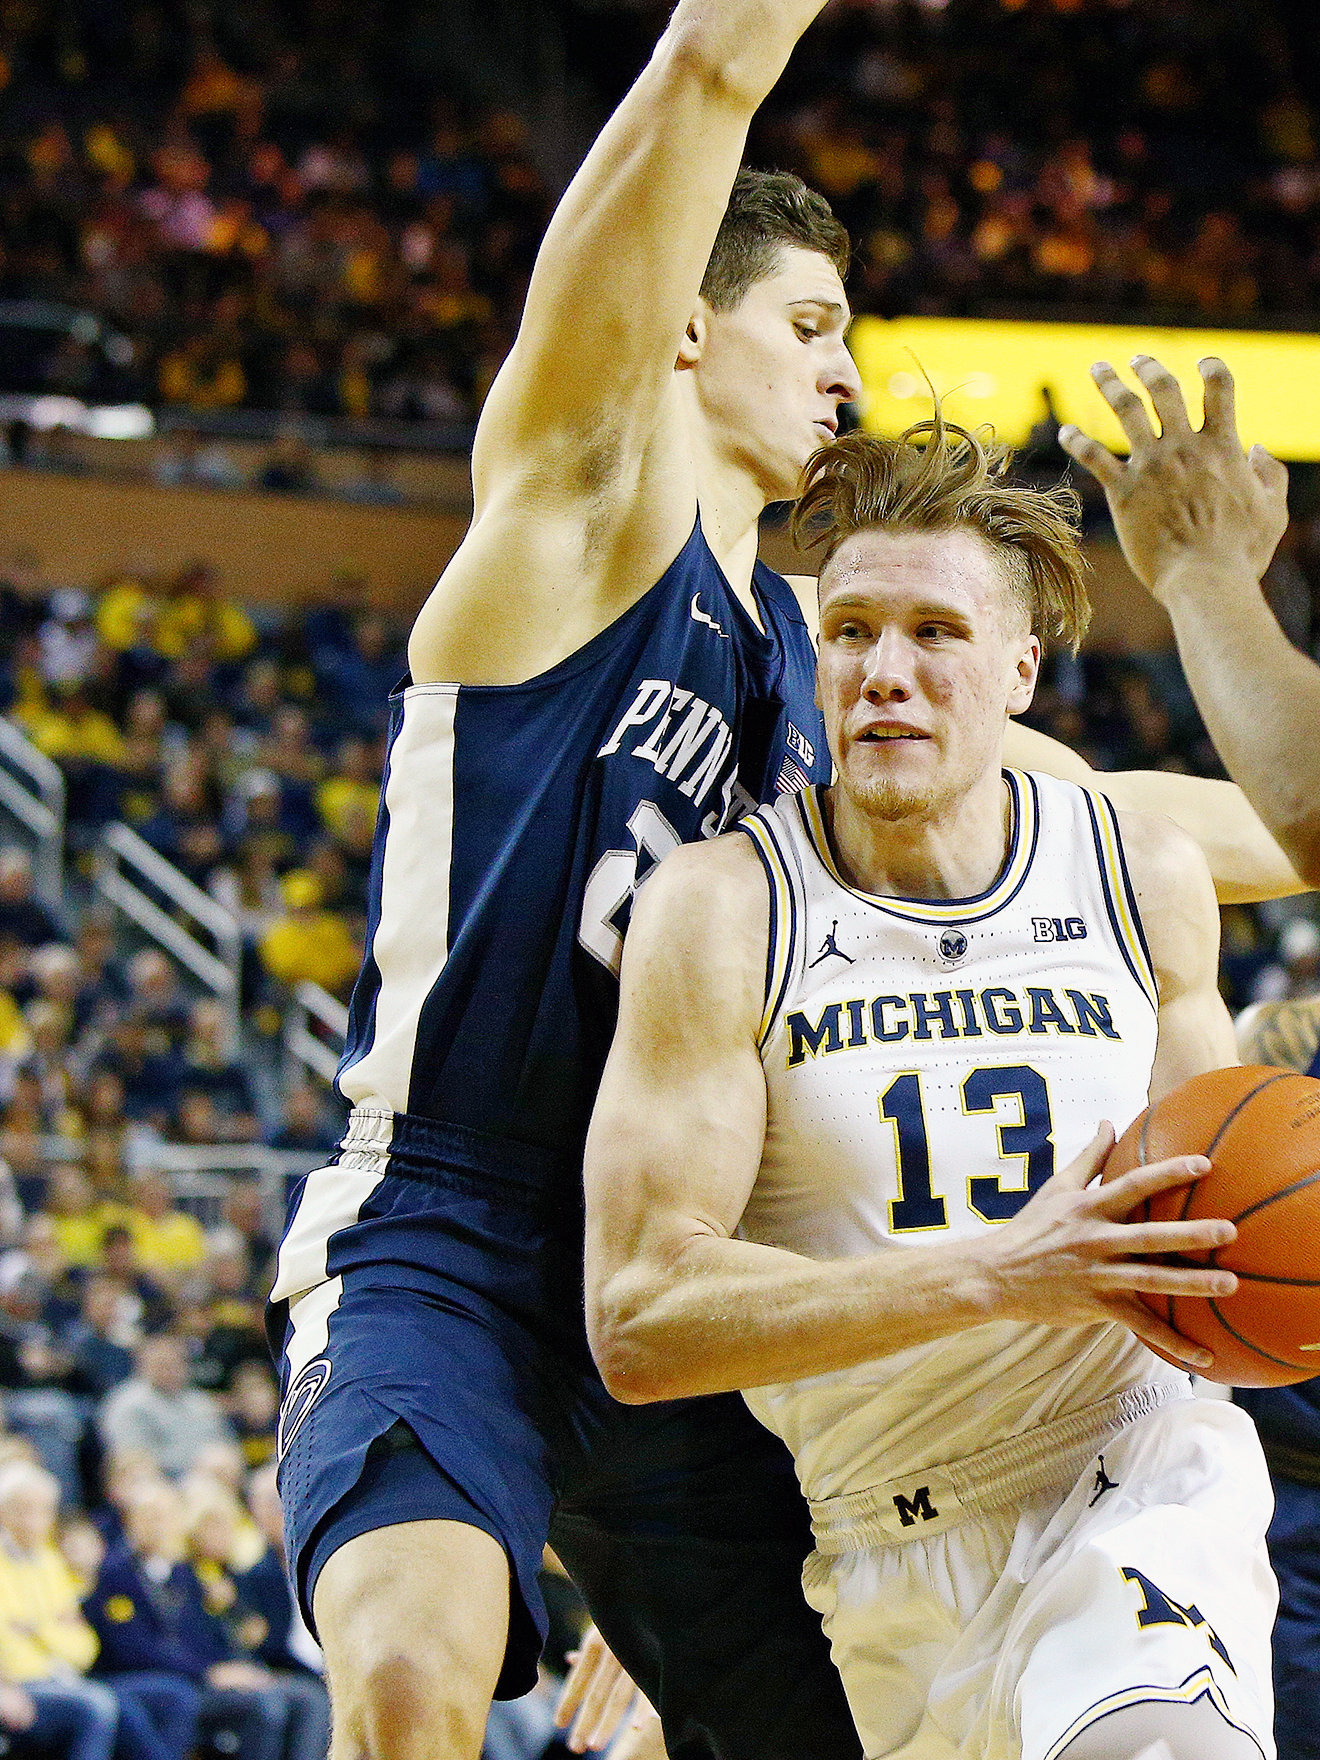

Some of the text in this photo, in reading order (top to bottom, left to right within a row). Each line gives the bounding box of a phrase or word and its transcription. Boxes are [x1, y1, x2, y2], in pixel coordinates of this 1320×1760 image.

[597, 678, 733, 808] PENN
[940, 936, 967, 957] M
[784, 987, 1125, 1070] MICHIGAN
[877, 1063, 1057, 1235] 13
[892, 1485, 939, 1528] M
